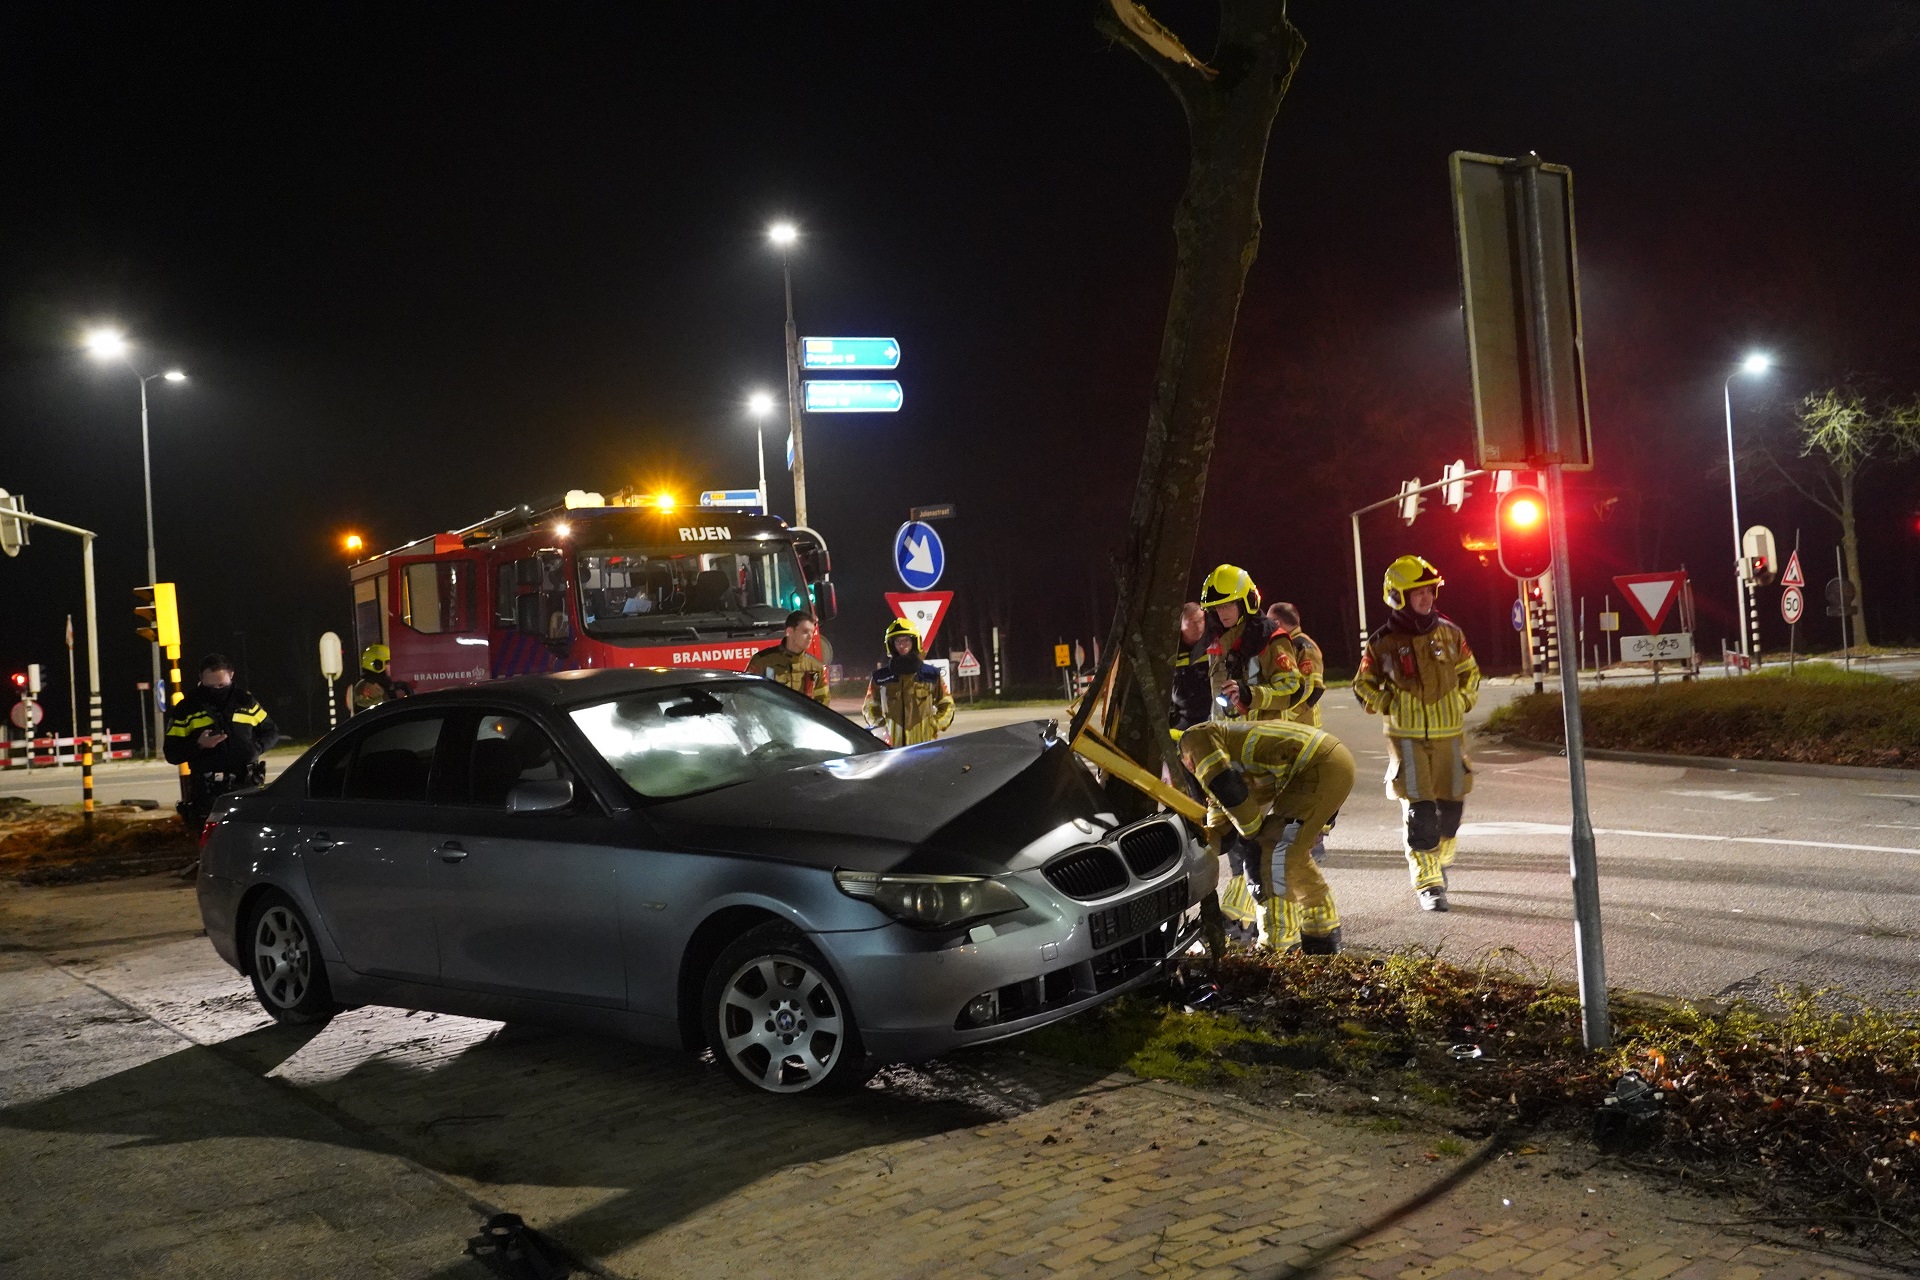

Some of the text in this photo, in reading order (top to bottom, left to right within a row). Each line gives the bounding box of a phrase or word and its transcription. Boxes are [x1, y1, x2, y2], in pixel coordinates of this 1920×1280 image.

[678, 526, 732, 541] RIJEN
[1785, 597, 1799, 612] 50
[413, 671, 472, 681] BRANDWEER
